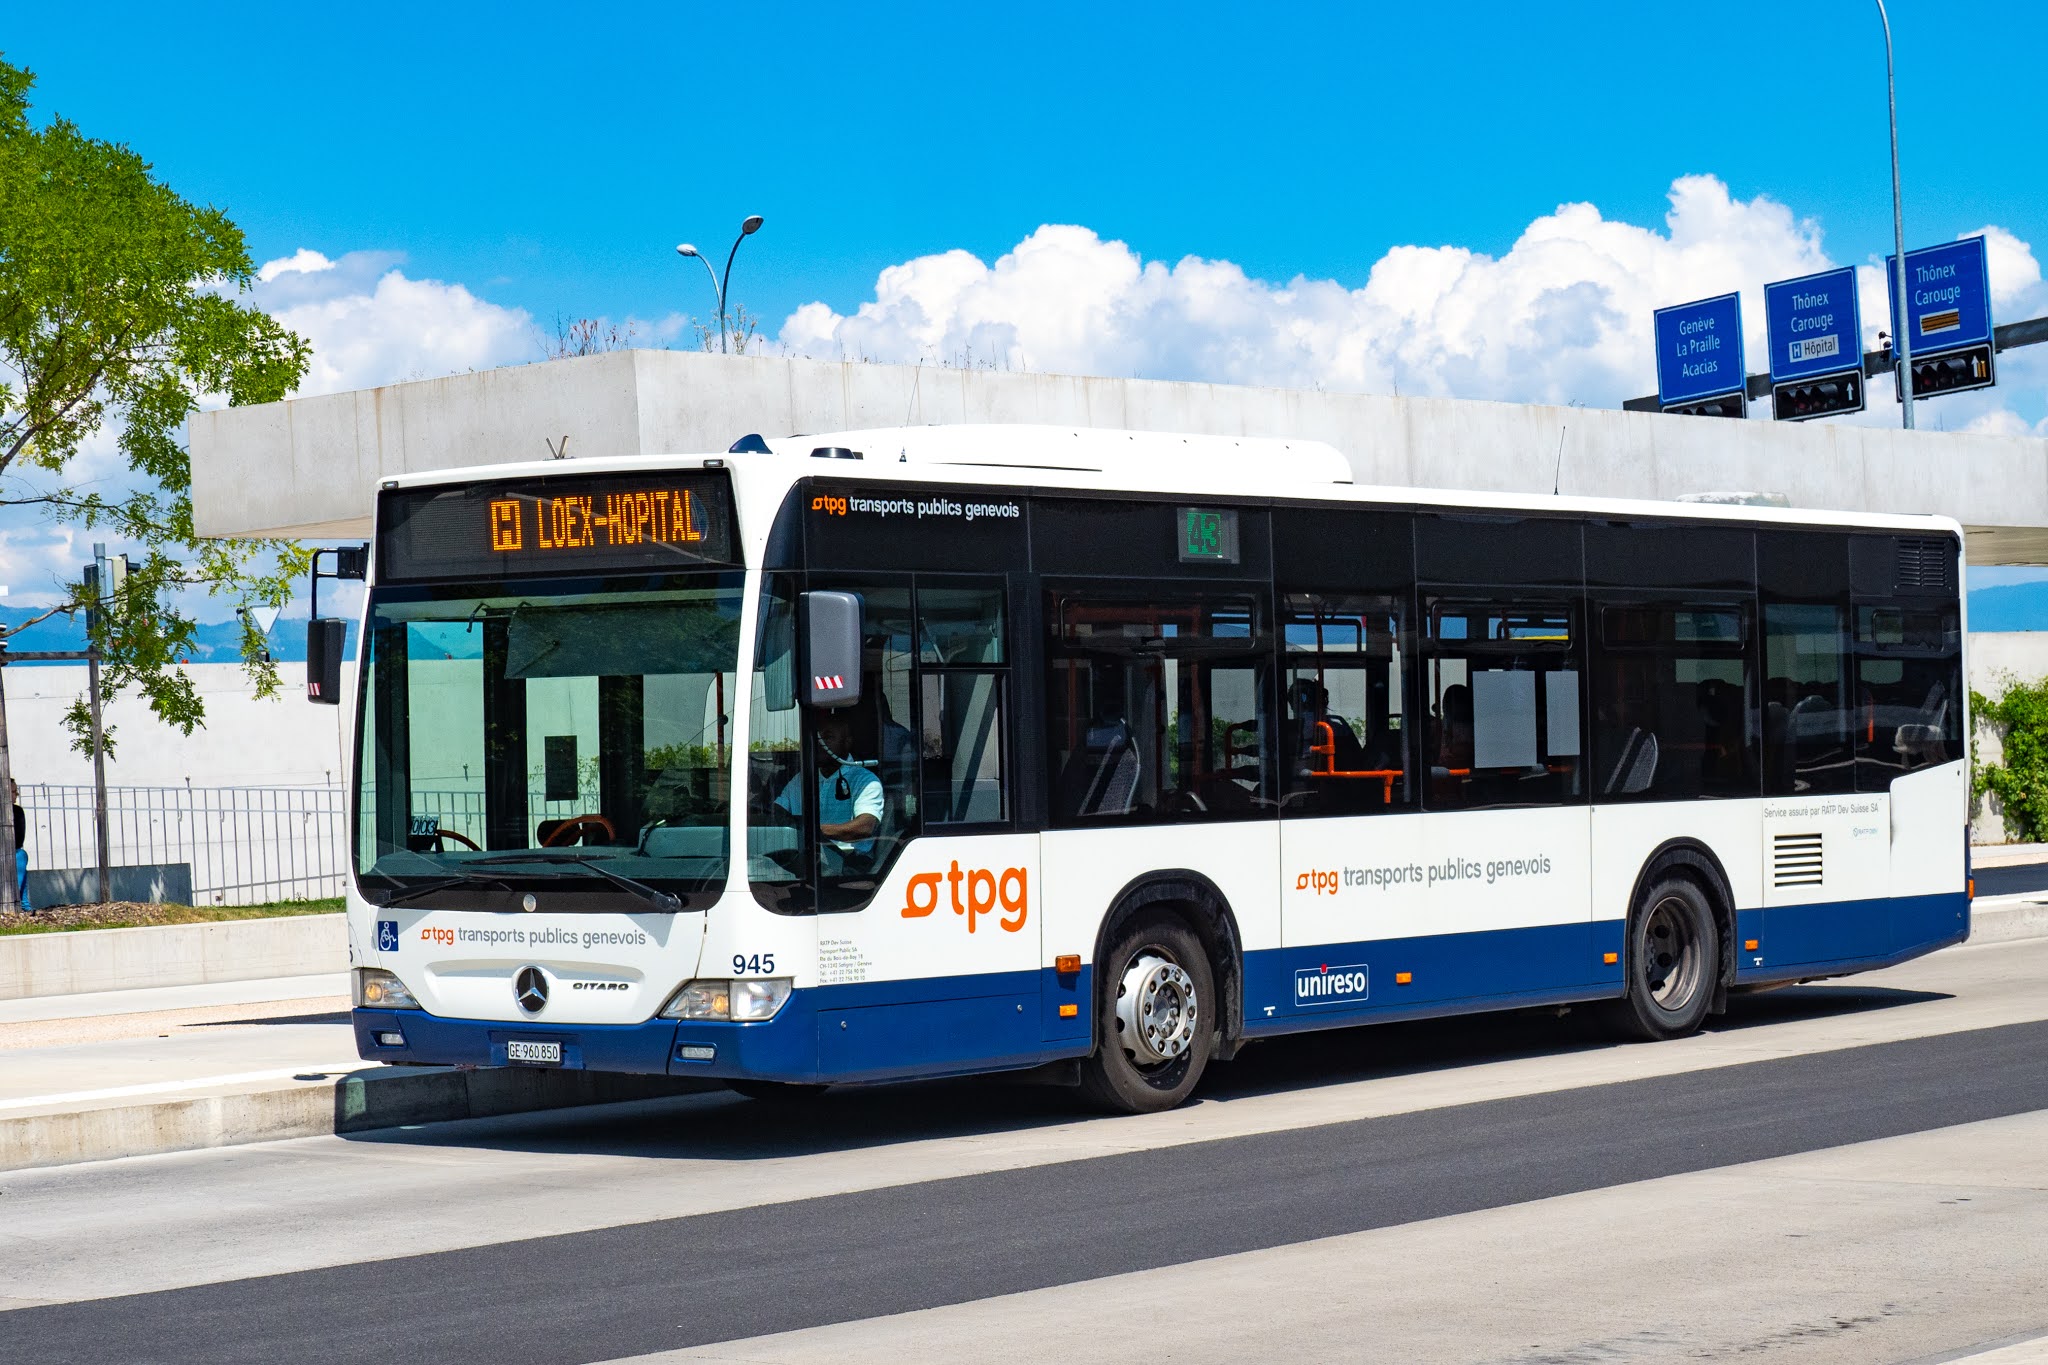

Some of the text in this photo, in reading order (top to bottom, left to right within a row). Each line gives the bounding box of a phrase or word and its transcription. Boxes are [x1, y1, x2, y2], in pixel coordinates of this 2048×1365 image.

[1916, 264, 1956, 283] Thônex
[1792, 292, 1829, 311] Thônex
[1915, 286, 1961, 306] Carouge
[1680, 317, 1715, 335] Genève
[1791, 314, 1833, 332] Carouge
[1677, 334, 1721, 357] La Praille
[1804, 337, 1836, 356] Hôpital
[1682, 359, 1718, 378] Acacias
[537, 490, 701, 549] LOEX-HOPITAL
[850, 496, 914, 518] transports
[918, 498, 962, 519] publics
[965, 501, 1020, 521] genevois
[1187, 513, 1221, 554] 43
[1764, 803, 1879, 818] Service assuré par RATP Dev Suisse SA
[1343, 862, 1423, 891] transports
[1428, 858, 1482, 888] publics
[1486, 853, 1551, 884] genevois
[948, 860, 1028, 934] tpg
[458, 927, 525, 946] transports
[529, 928, 578, 948] publics
[583, 930, 646, 949] genevois
[732, 953, 776, 975] 945
[1297, 964, 1366, 998] unireso
